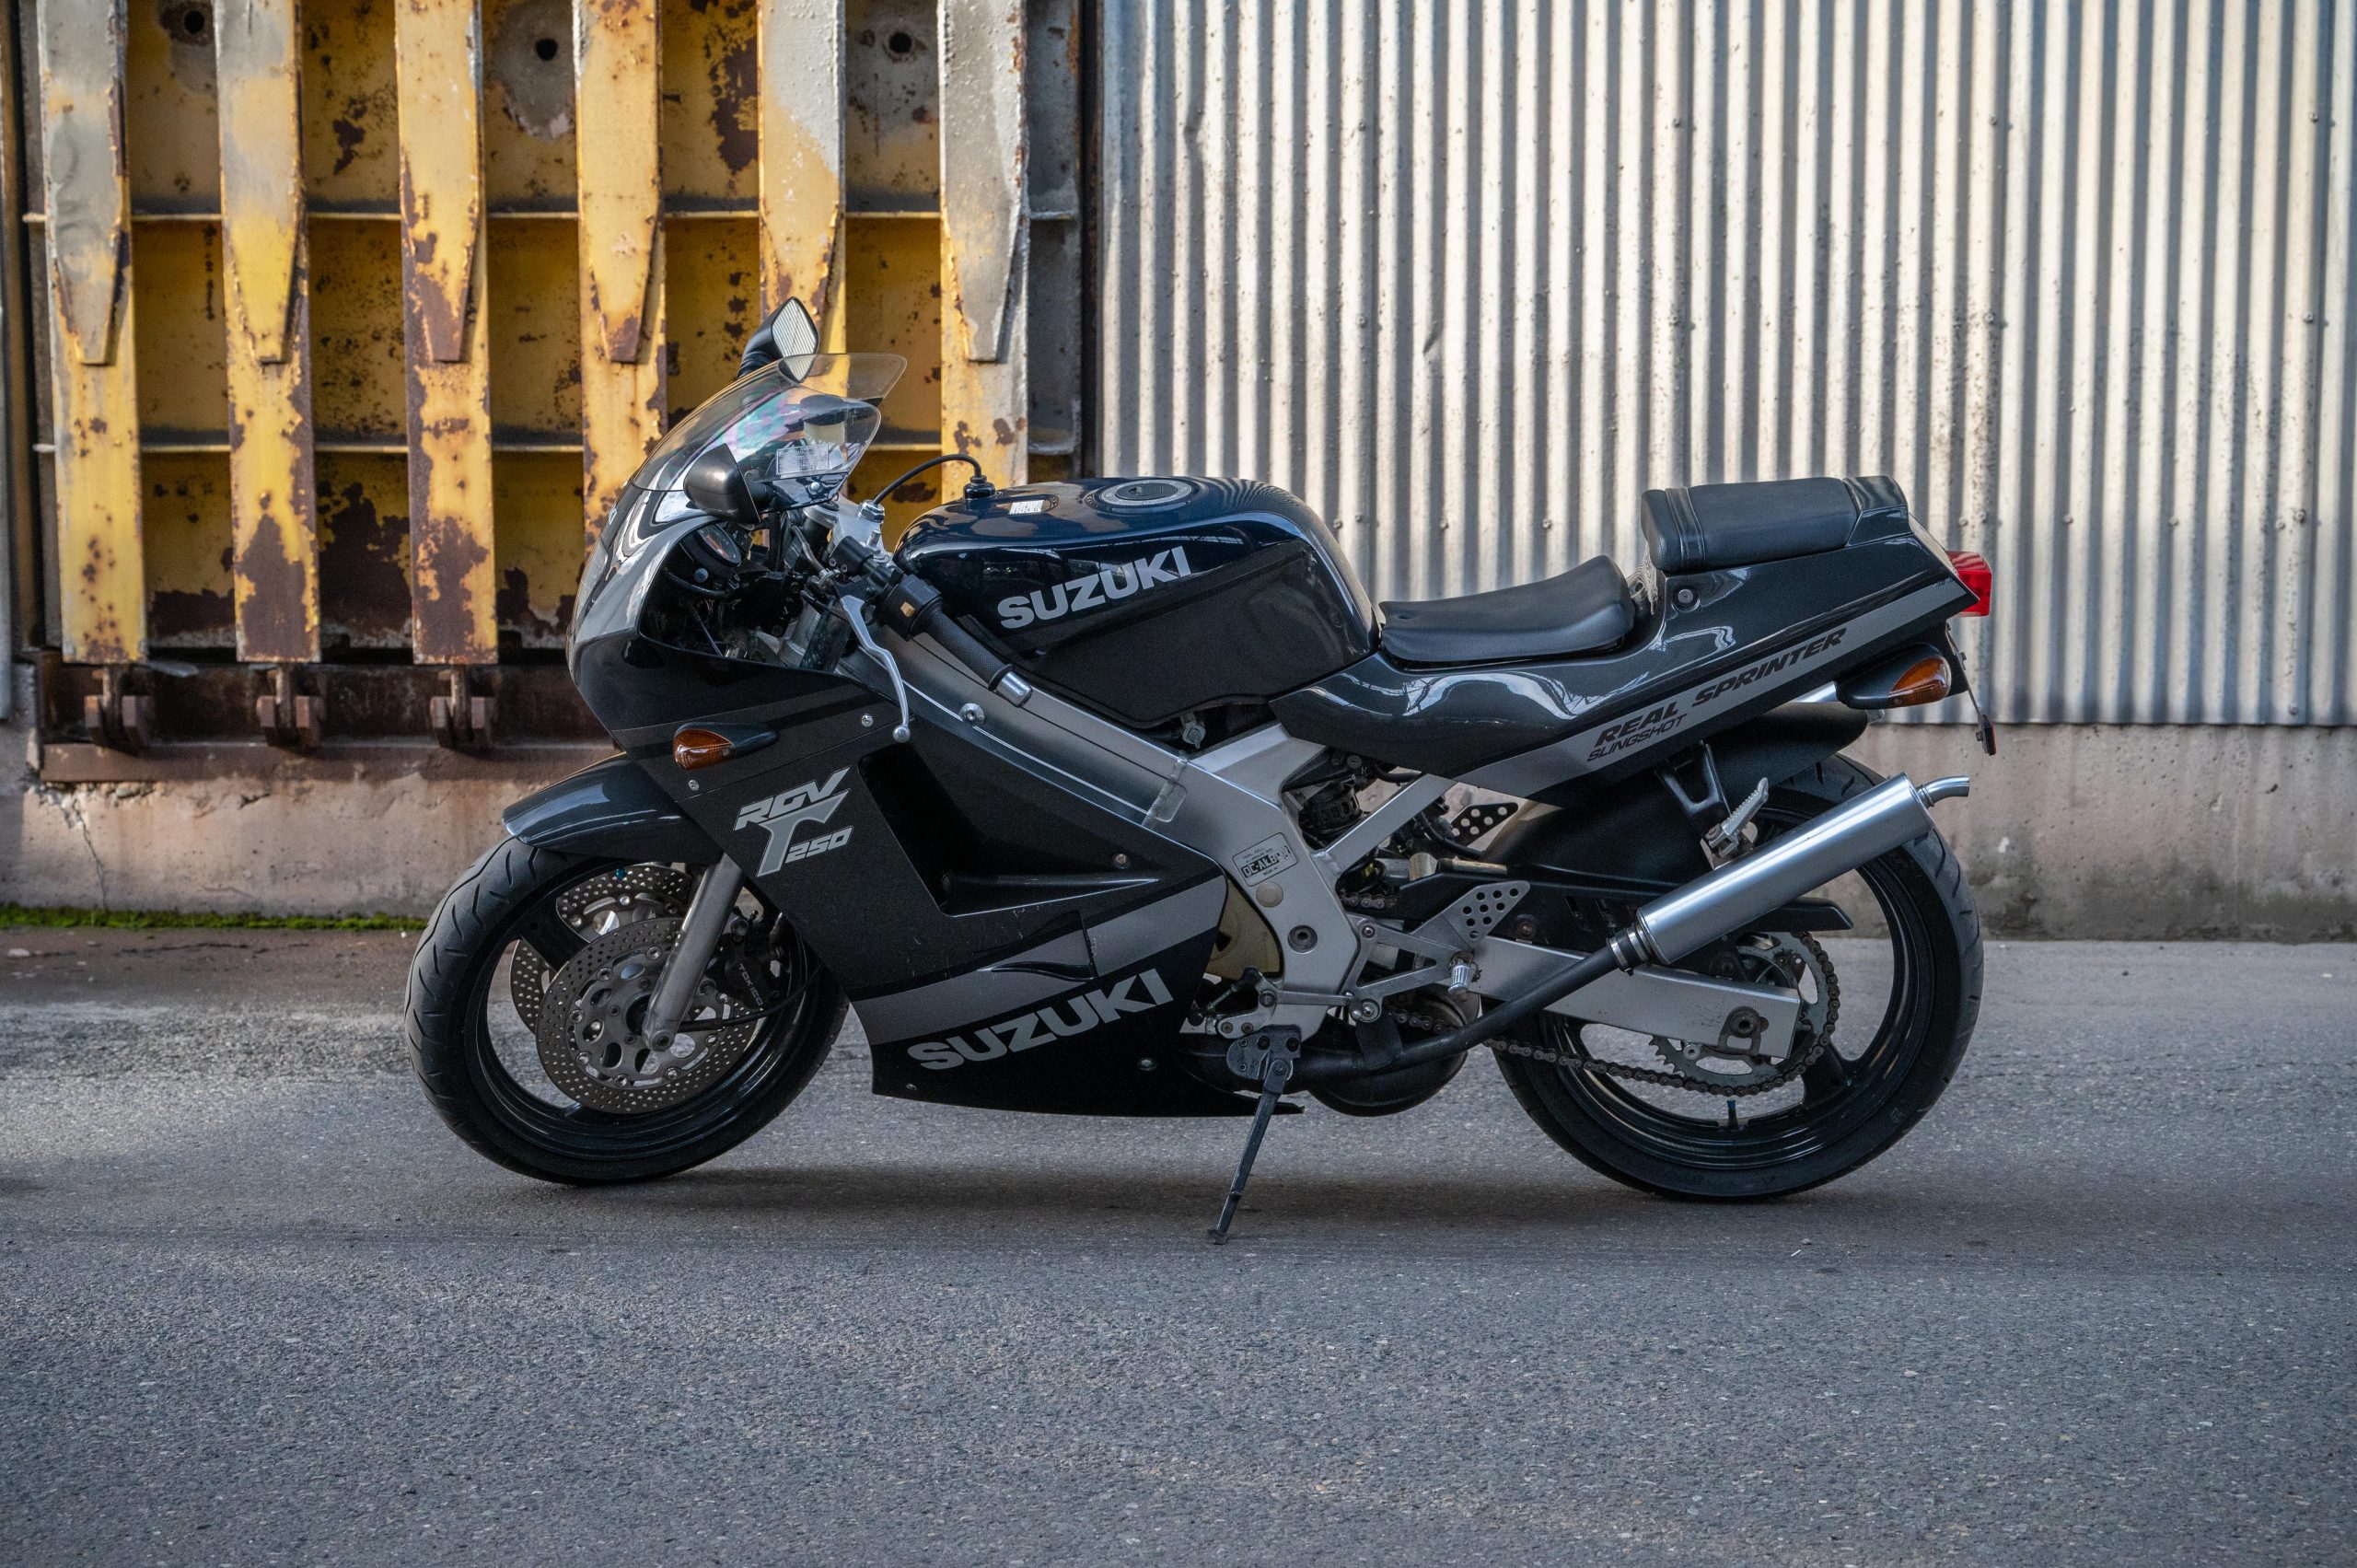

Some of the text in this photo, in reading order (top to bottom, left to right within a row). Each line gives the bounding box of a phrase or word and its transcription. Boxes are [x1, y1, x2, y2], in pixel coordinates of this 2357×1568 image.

[997, 546, 1192, 629] SUZUKI
[1594, 627, 1848, 748] REAL SPRINTER
[1586, 713, 1689, 762] SLINGSHOT
[734, 766, 851, 830] RGV
[784, 827, 853, 864] 250
[738, 962, 764, 1007] TOKICO
[907, 968, 1174, 1070] SUZUKI
